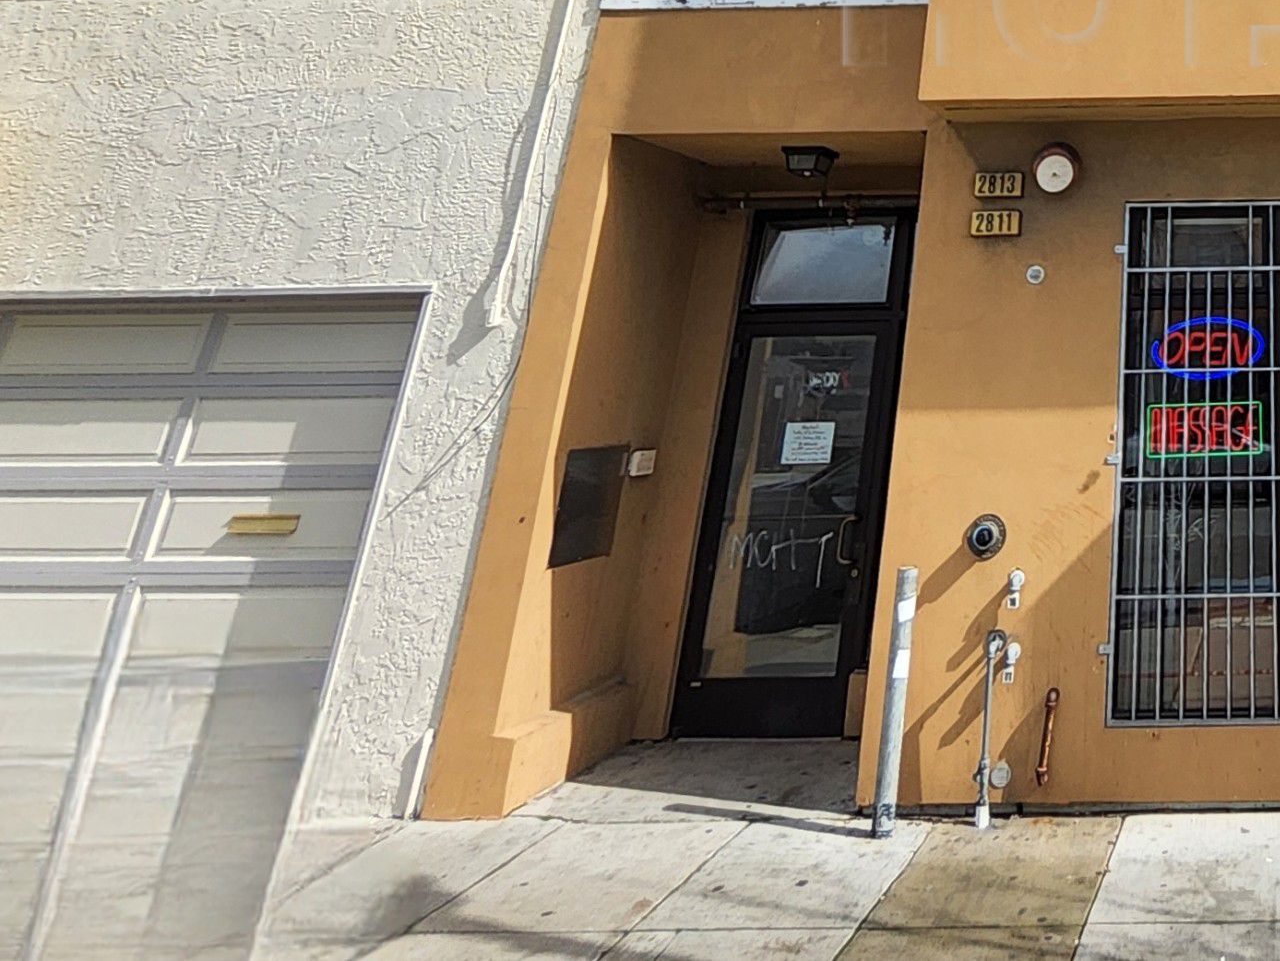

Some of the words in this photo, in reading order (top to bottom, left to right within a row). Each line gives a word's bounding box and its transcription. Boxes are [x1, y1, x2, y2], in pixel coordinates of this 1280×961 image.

[978, 175, 1016, 194] 2813
[975, 212, 1013, 233] 2811
[1159, 331, 1253, 365] OPEN
[1150, 405, 1258, 454] MASSAGE
